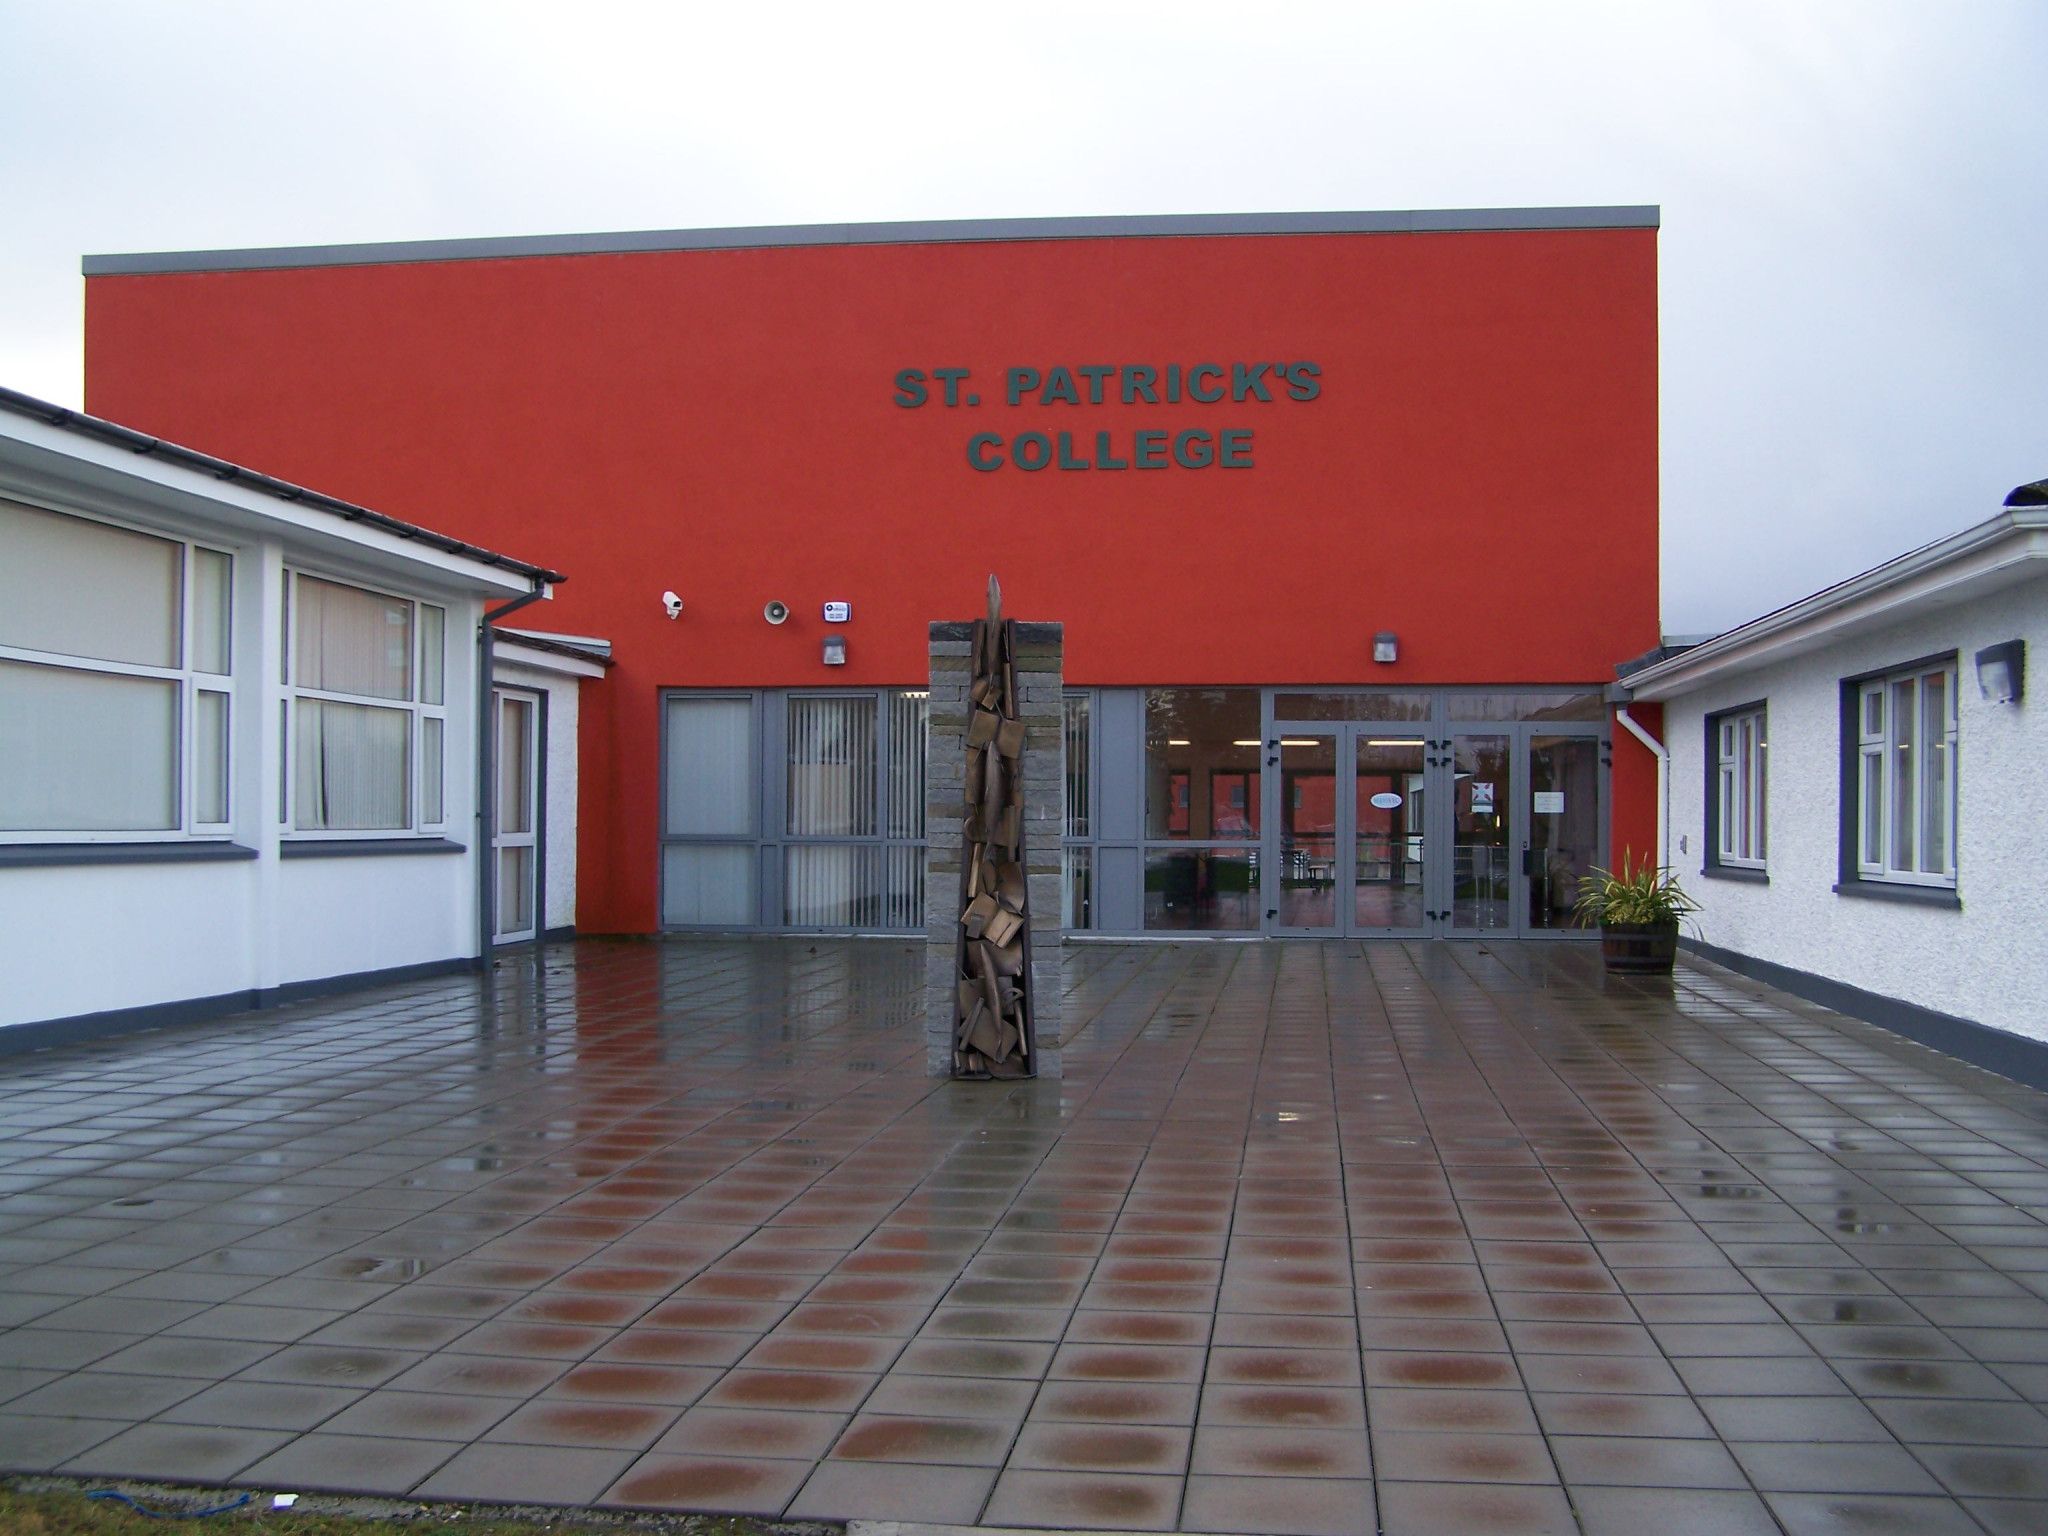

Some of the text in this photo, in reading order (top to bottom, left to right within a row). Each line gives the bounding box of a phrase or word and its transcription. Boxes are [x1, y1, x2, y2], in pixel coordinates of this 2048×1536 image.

[894, 362, 1321, 407] ST. PATRICK'S
[967, 429, 1254, 471] COLLEGE
